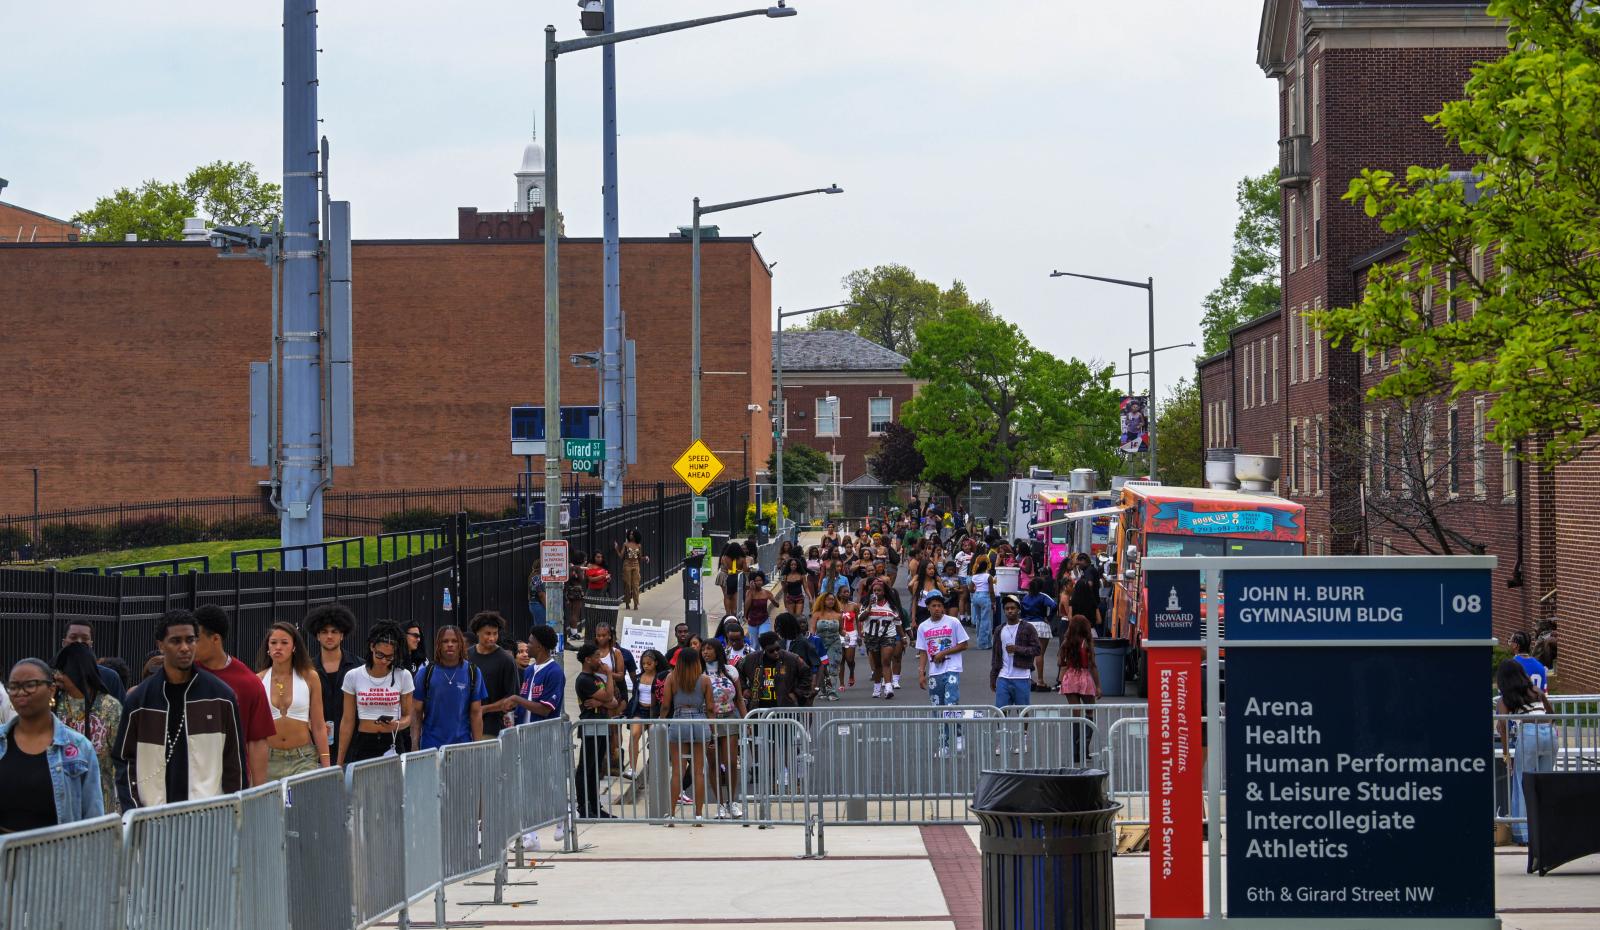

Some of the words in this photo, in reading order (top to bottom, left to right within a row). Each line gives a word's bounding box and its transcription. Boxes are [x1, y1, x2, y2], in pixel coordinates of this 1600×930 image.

[566, 441, 591, 457] Girard
[593, 442, 600, 450] ST
[572, 459, 591, 471] 600
[687, 471, 711, 479] AHEAD
[1239, 586, 1288, 602] JOHN
[1294, 586, 1311, 601] H.
[1317, 586, 1364, 601] BURR
[1452, 594, 1482, 613] 08
[1155, 613, 1194, 621] HOWARD
[1239, 607, 1351, 623] GYMNASIUM
[1357, 607, 1403, 622] BLDG
[1177, 670, 1189, 710] Veritas
[1160, 669, 1172, 739] Excellence
[1244, 696, 1313, 716] Arena
[1177, 710, 1187, 723] et
[1246, 725, 1321, 745] Health
[1161, 742, 1172, 755] in
[1178, 725, 1189, 774] Utilitas.
[1246, 753, 1329, 773] Human
[1337, 753, 1486, 773] Performance
[1162, 758, 1173, 795] Truth
[1246, 781, 1264, 802] &
[1270, 782, 1351, 801] Leisure
[1357, 781, 1443, 801] Studies
[1162, 799, 1174, 824] and
[1247, 810, 1415, 832] Intercollegiate
[1162, 828, 1174, 880] Service.
[1245, 837, 1348, 858] Athletics
[1247, 886, 1275, 902] 6th
[1280, 886, 1293, 902] &
[1296, 886, 1346, 902] Girard
[1351, 886, 1400, 902] Street
[1405, 886, 1434, 902] NW
